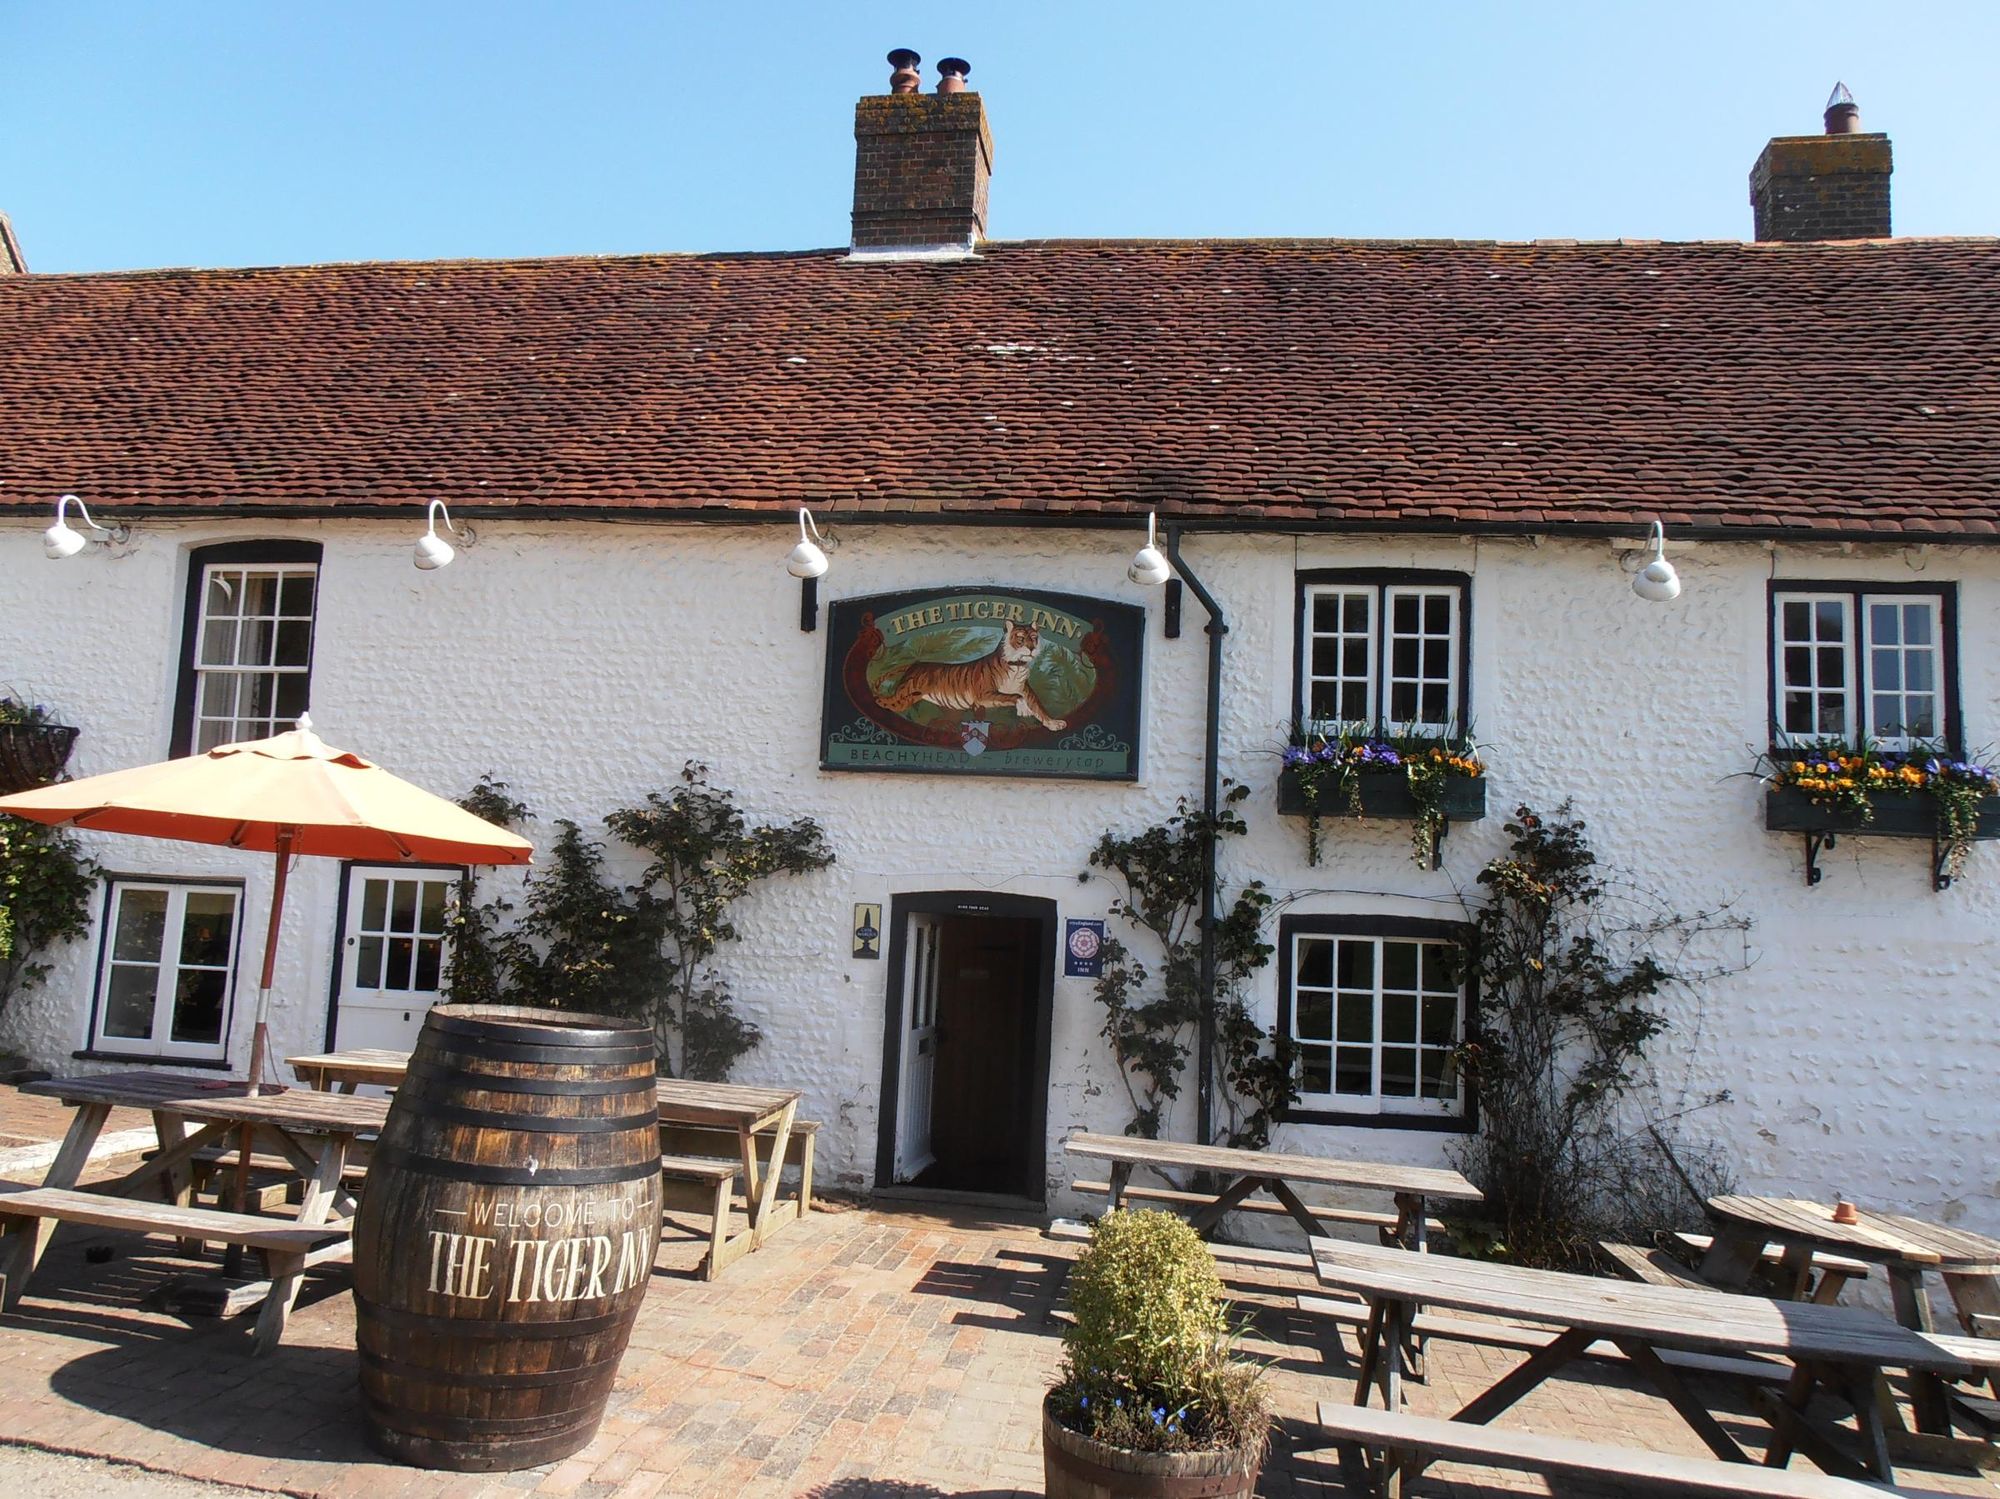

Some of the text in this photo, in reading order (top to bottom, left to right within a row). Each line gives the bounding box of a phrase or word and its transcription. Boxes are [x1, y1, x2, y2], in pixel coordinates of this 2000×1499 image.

[890, 606, 944, 635] THE
[946, 601, 1024, 622] TIGER
[850, 750, 1105, 768] BEACHYHEAD brewerytap
[474, 1197, 635, 1228] WELCOME TO
[427, 1230, 496, 1300] THE
[507, 1236, 612, 1303] TIGER
